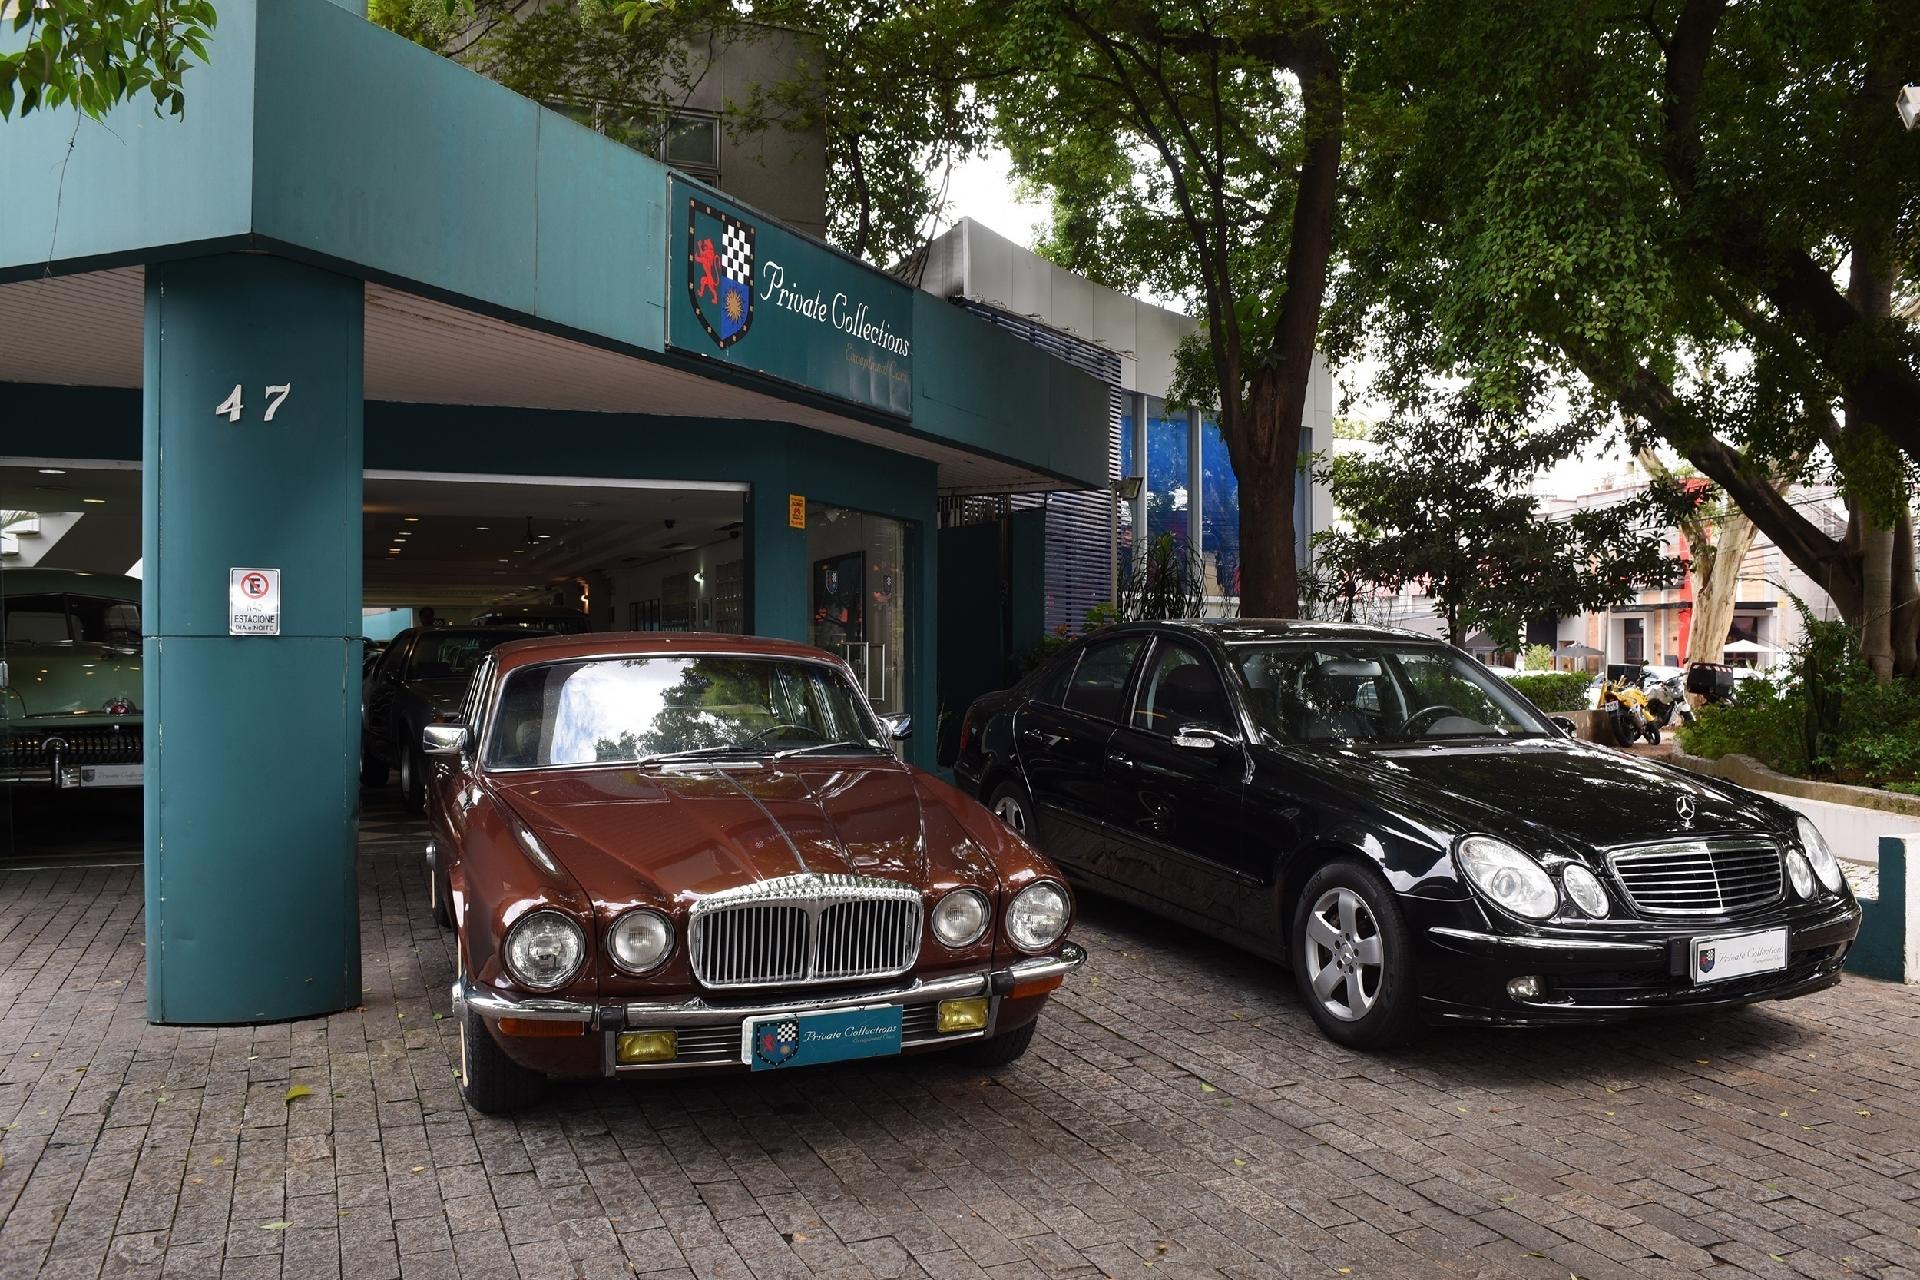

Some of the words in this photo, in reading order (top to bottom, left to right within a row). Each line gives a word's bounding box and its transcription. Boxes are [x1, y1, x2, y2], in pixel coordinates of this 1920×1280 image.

[760, 260, 827, 323] Private
[832, 292, 911, 357] Collections
[234, 614, 275, 624] ESTACIONE
[802, 1029, 842, 1043] Private
[844, 1025, 897, 1037] Collections
